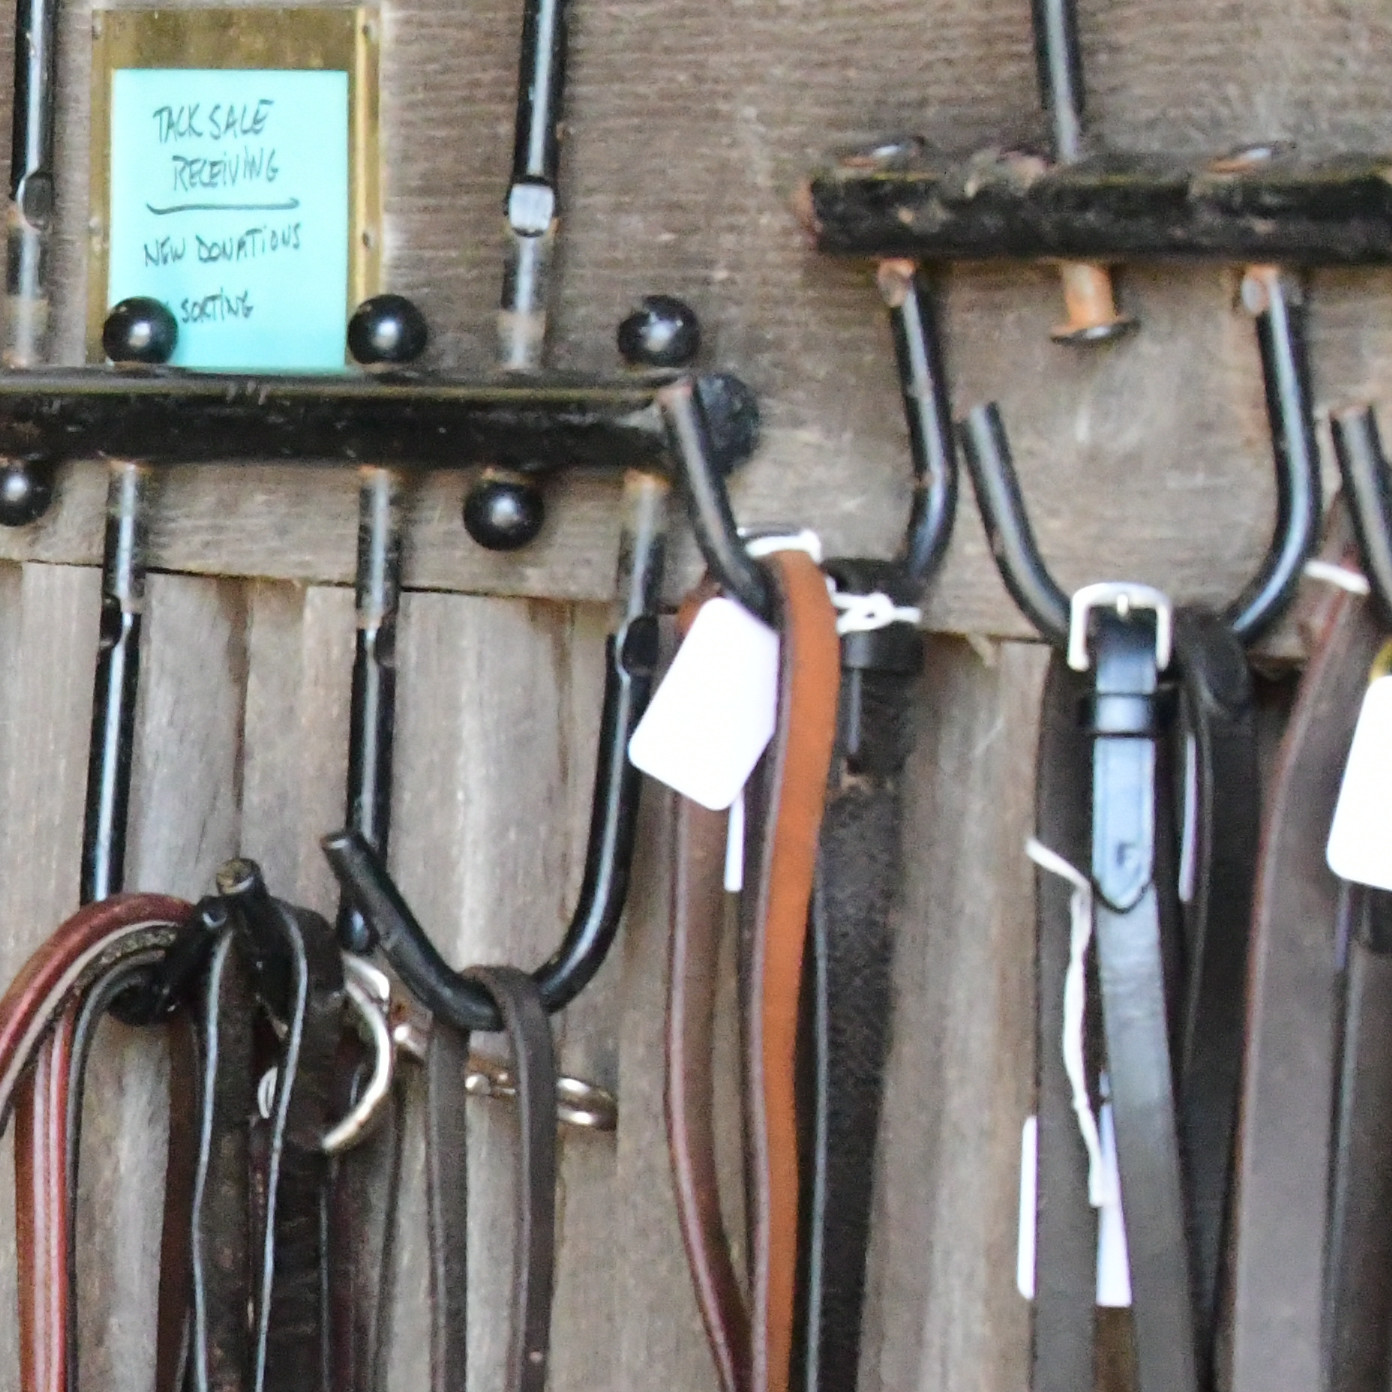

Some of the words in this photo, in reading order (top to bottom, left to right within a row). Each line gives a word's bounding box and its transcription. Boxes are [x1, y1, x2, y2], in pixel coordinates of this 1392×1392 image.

[152, 103, 203, 143] TACK
[209, 99, 274, 140] SALE
[144, 236, 186, 267] NEW
